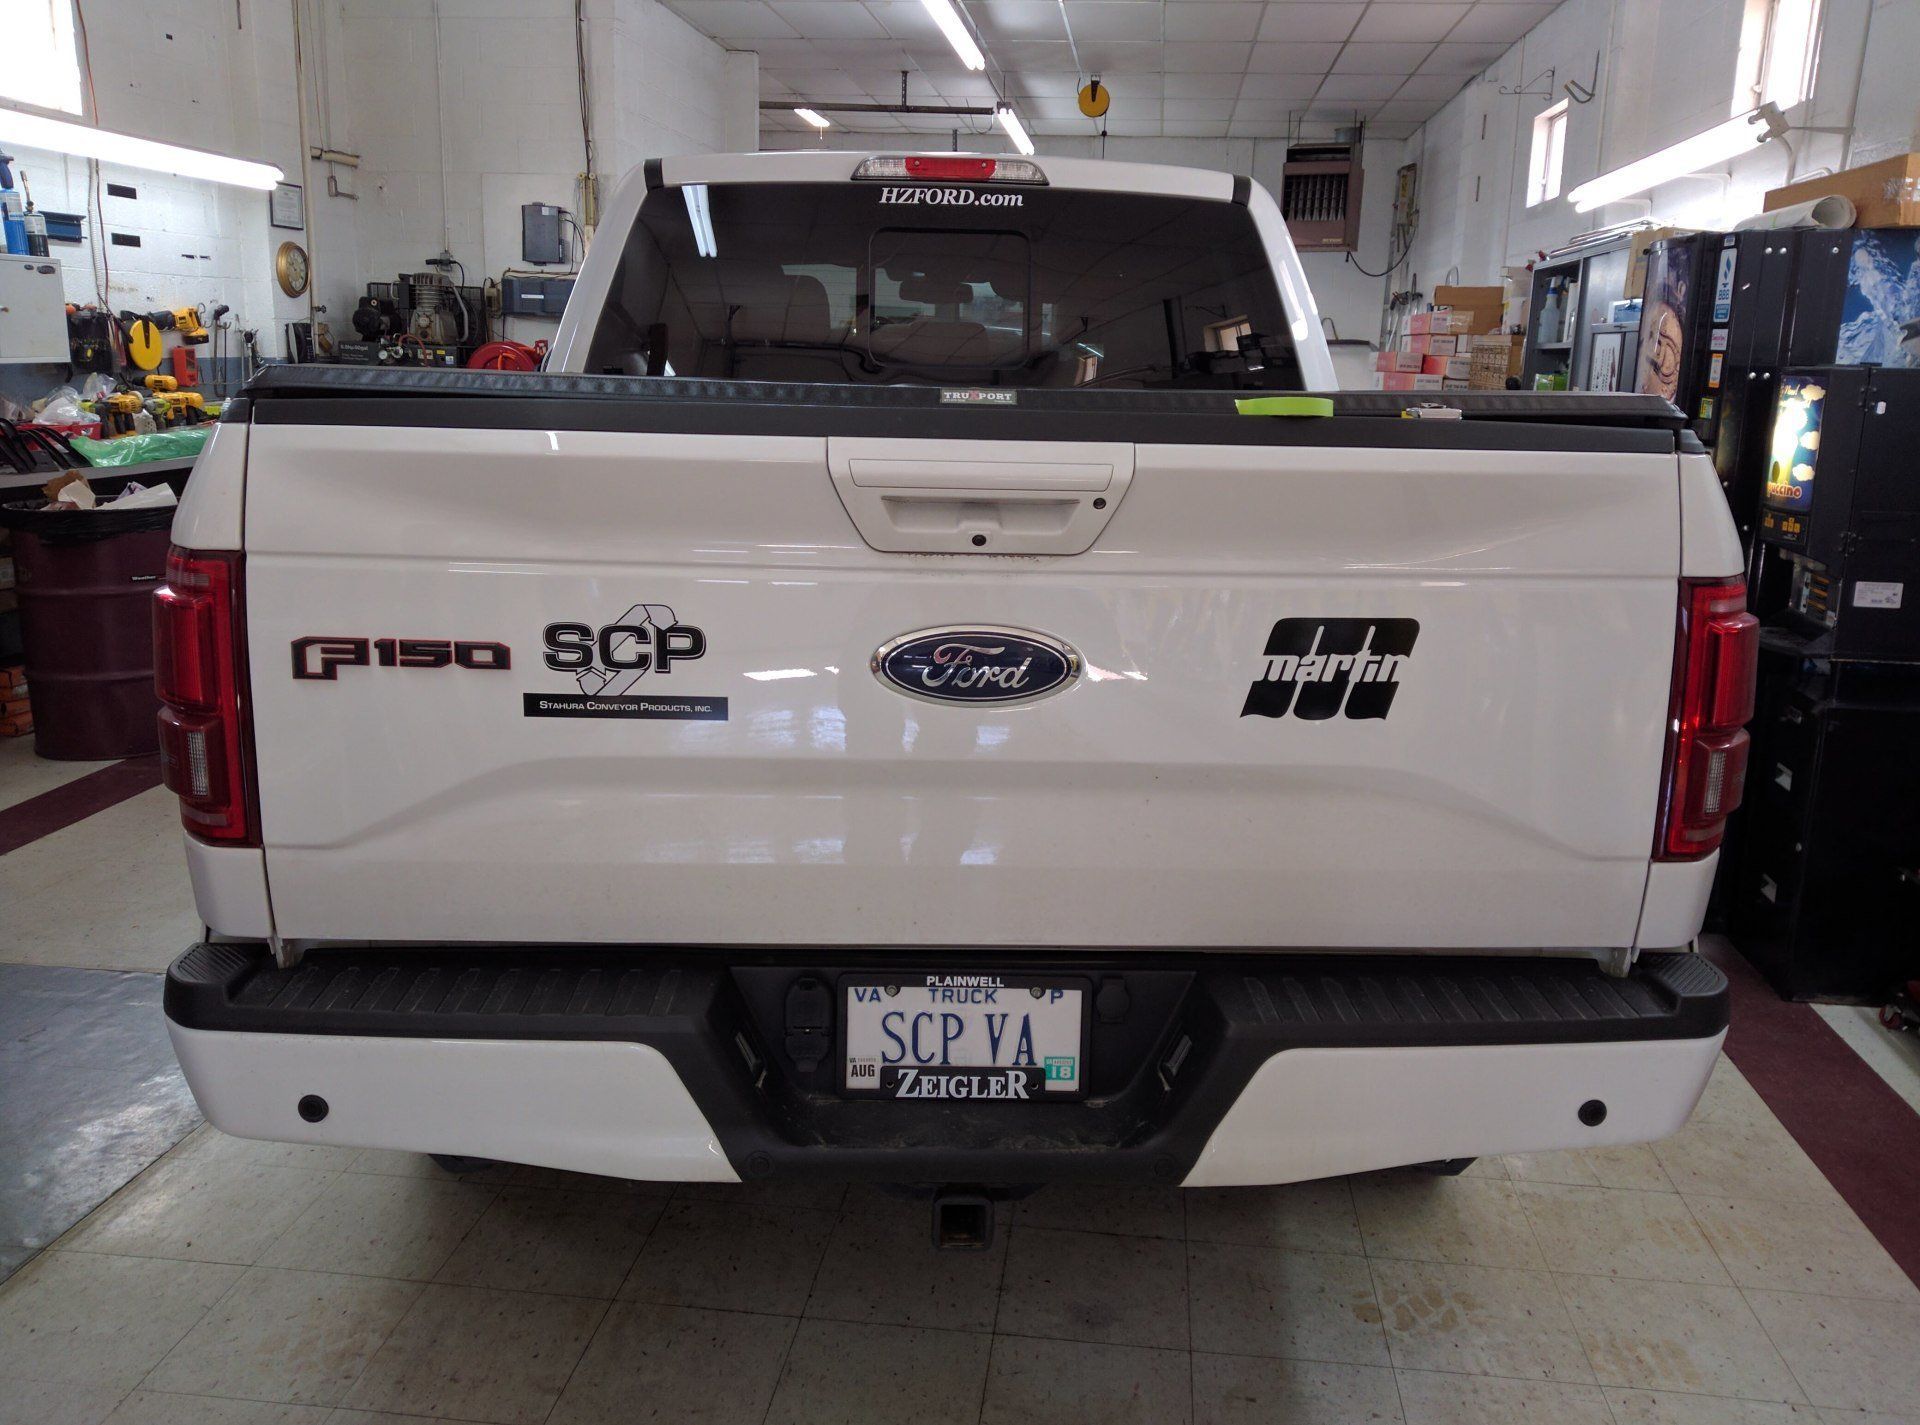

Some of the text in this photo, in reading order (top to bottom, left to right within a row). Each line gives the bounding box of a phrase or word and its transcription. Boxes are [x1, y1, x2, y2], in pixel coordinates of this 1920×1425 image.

[879, 187, 1024, 207] HZFORD.com
[943, 390, 1012, 401] TRUXPORT
[291, 636, 511, 680] F150
[543, 622, 707, 673] SCP
[921, 643, 1033, 688] Ford
[1251, 649, 1409, 683] martin
[926, 975, 1005, 988] PLAINWELL
[854, 988, 881, 1002] VA
[928, 988, 998, 1004] TRUCK
[881, 1011, 1037, 1066] SCP VA
[851, 1064, 875, 1077] AUG
[1051, 1065, 1072, 1079] 18
[895, 1068, 1030, 1100] ZEIGLER
